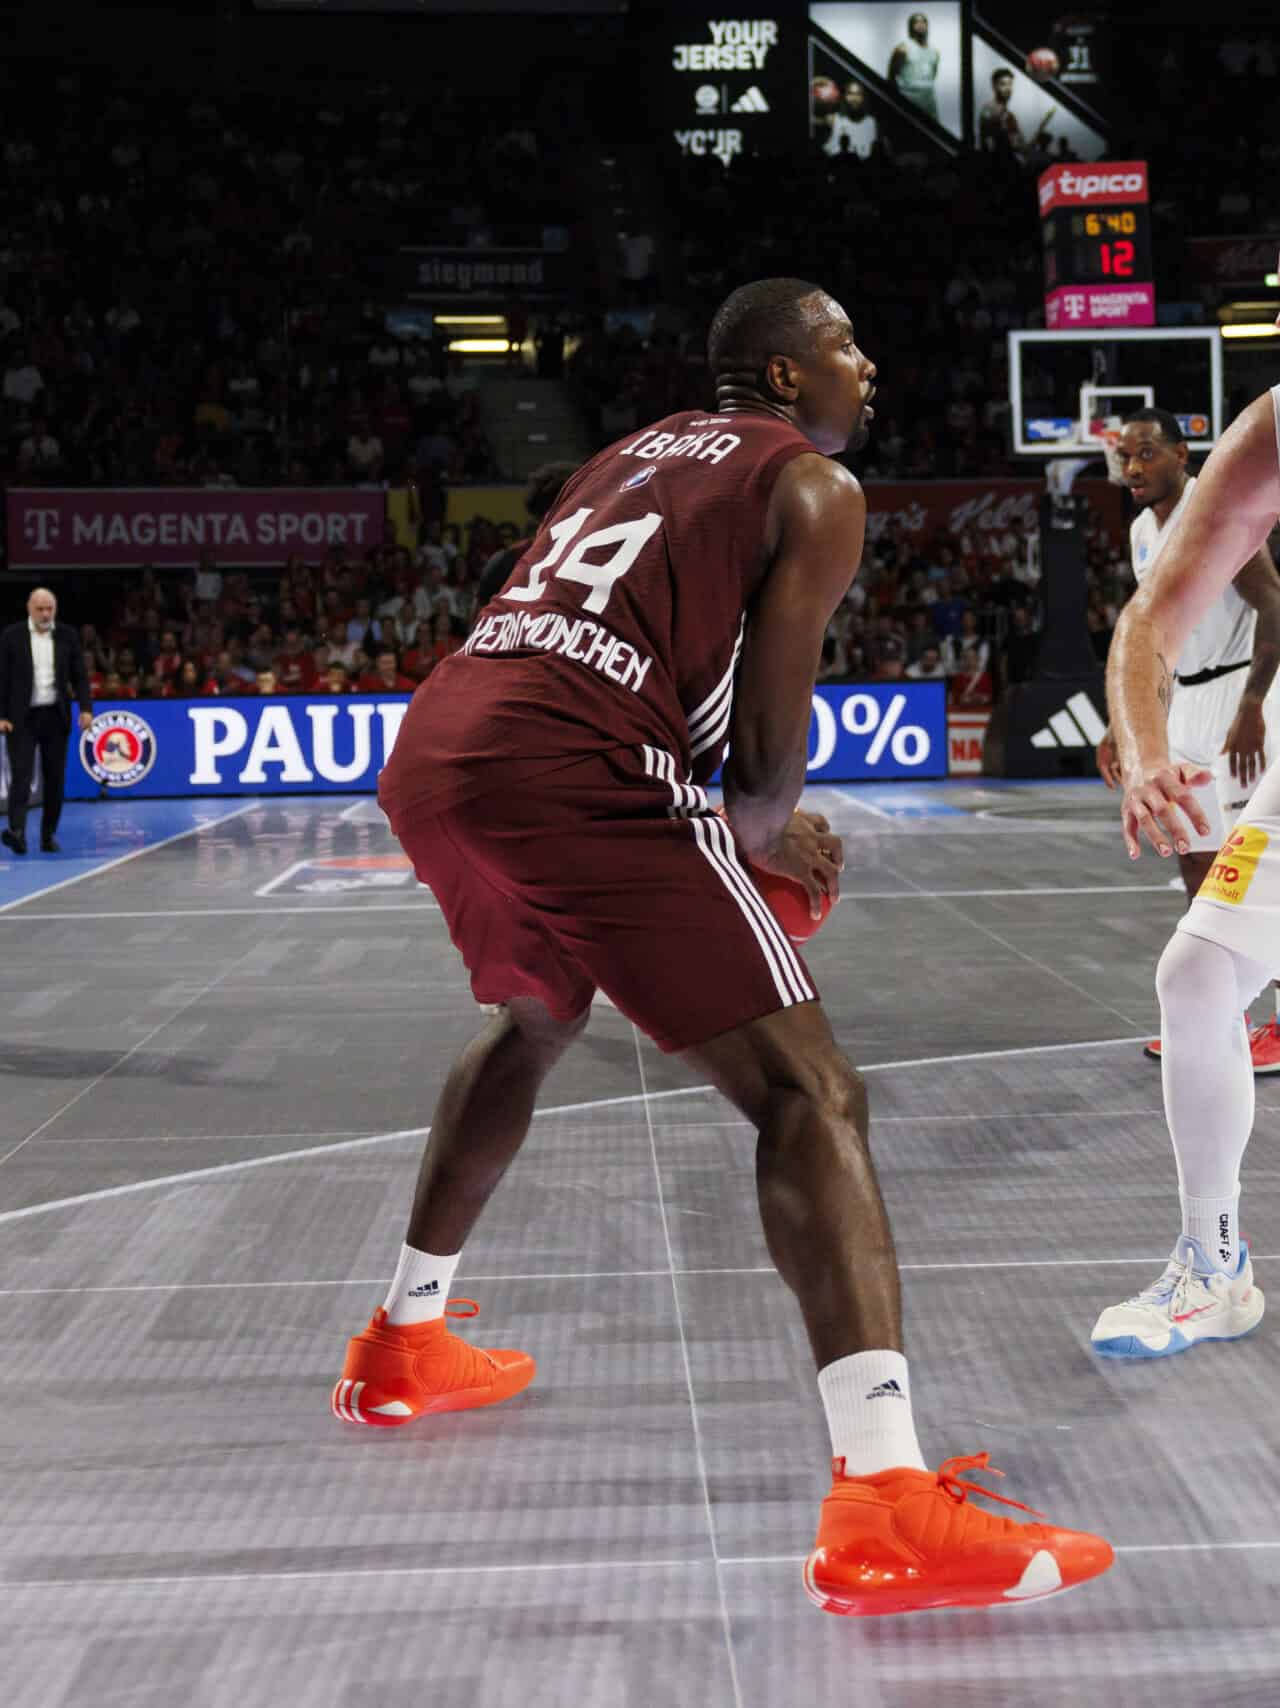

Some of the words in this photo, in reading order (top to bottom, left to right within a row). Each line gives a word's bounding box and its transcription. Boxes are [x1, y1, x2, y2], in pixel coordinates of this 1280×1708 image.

[708, 20, 777, 45] YOUR
[672, 45, 768, 70] JERSEY
[1058, 170, 1144, 198] tipico
[1101, 241, 1135, 276] 12
[619, 430, 741, 465] IBAKA
[73, 512, 250, 546] MAGENTA
[256, 511, 368, 545] SPORT
[501, 507, 663, 615] 14
[518, 610, 653, 693] MÜNCHEN
[1219, 1213, 1230, 1246] CRAFT
